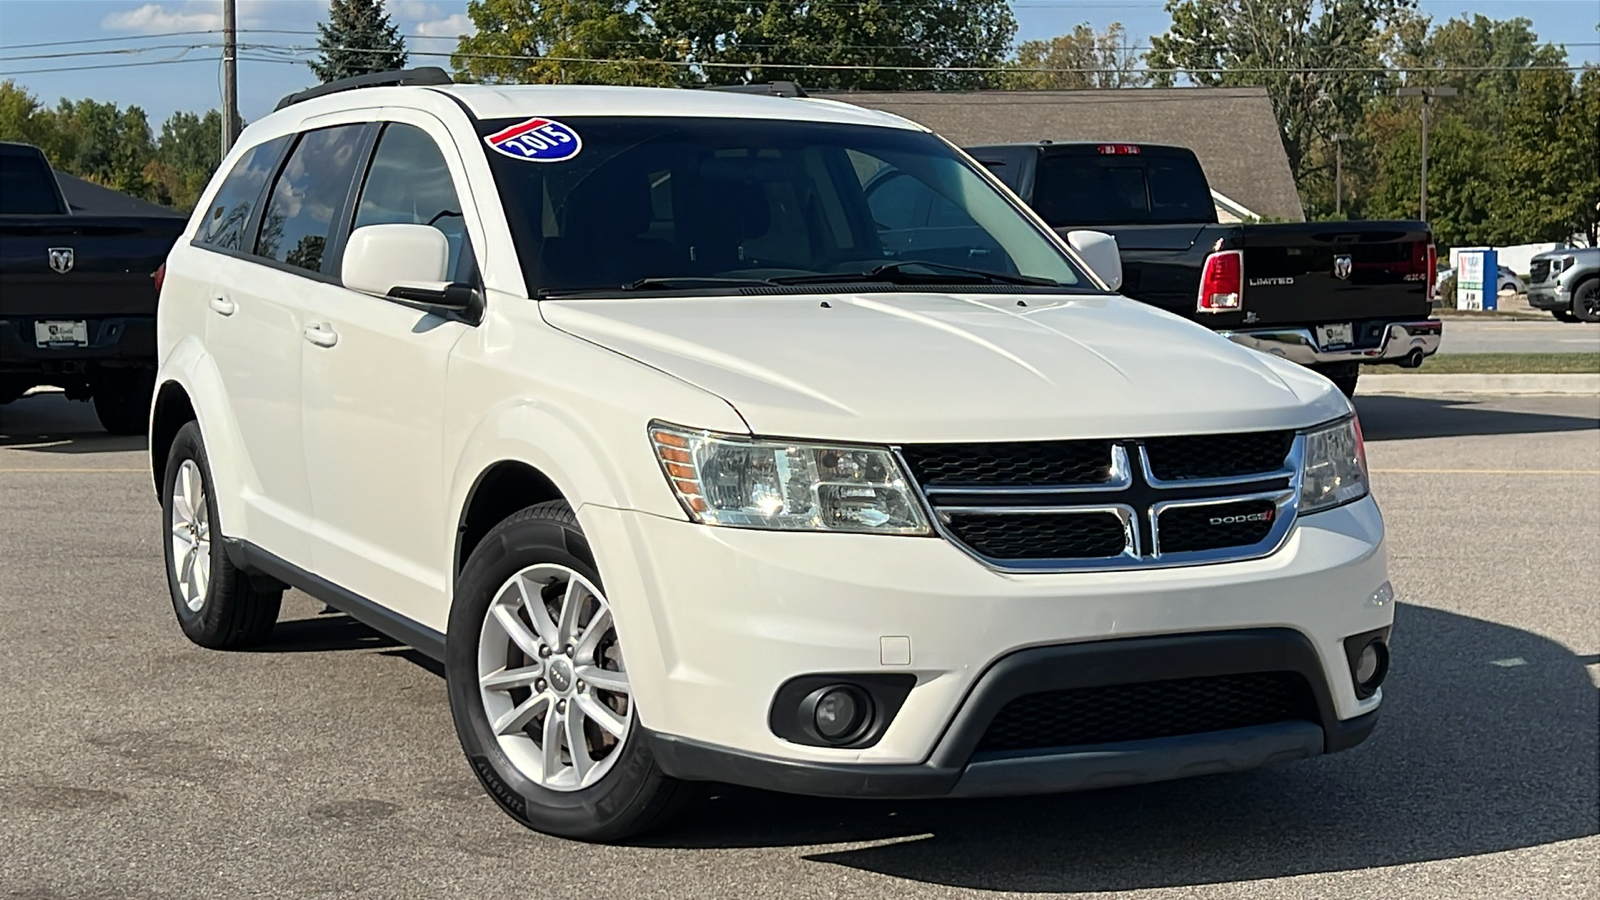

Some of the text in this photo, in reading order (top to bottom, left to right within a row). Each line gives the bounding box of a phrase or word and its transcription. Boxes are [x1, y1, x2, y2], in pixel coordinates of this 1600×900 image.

[505, 126, 571, 157] 2015
[1249, 277, 1294, 286] LIMITED
[1209, 512, 1266, 525] DODGE
